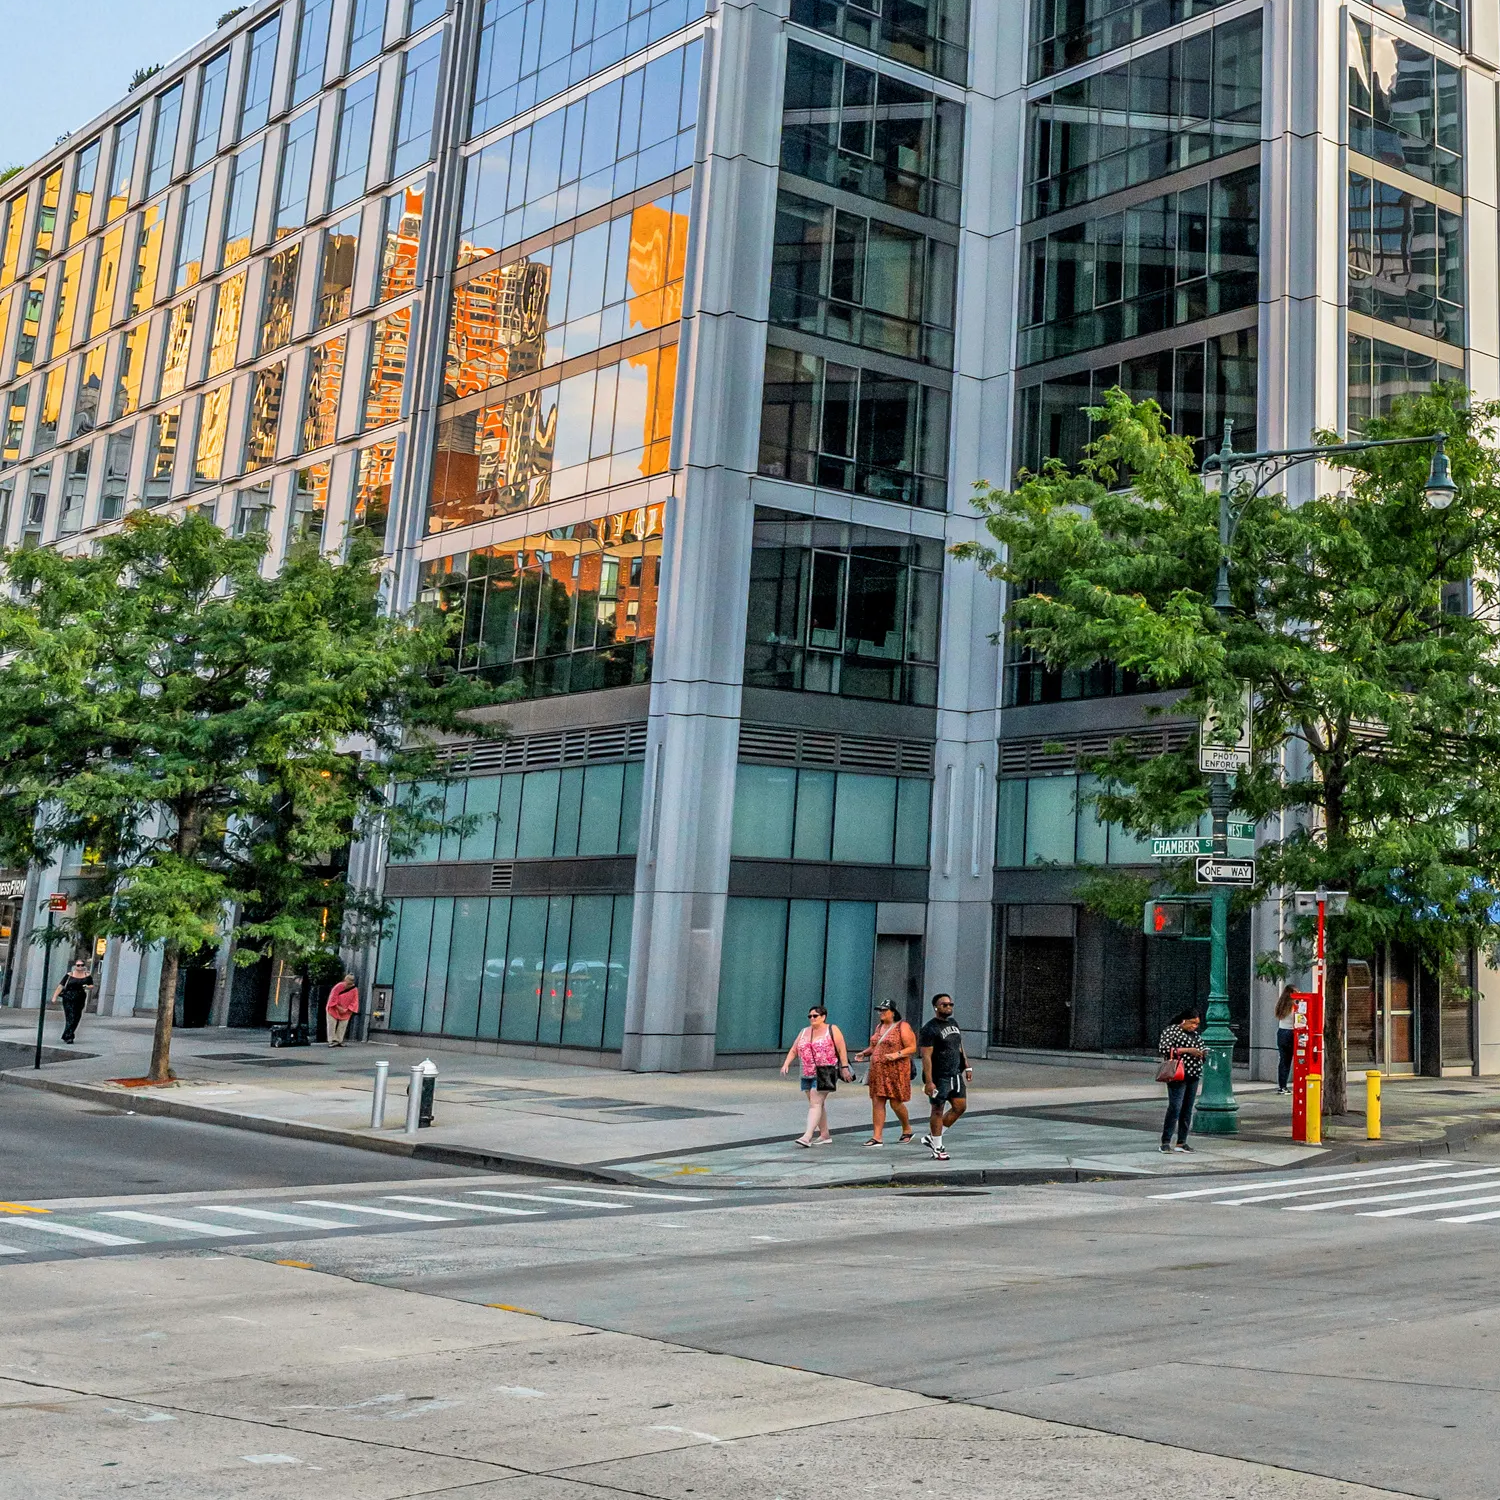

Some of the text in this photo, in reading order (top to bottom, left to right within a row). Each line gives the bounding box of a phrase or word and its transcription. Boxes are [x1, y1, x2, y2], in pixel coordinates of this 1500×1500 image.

[1213, 752, 1238, 760] PHOTO
[1205, 760, 1240, 769] ENFORCE
[1154, 840, 1199, 853] CHAMBERS
[1205, 867, 1249, 876] ONE WAY
